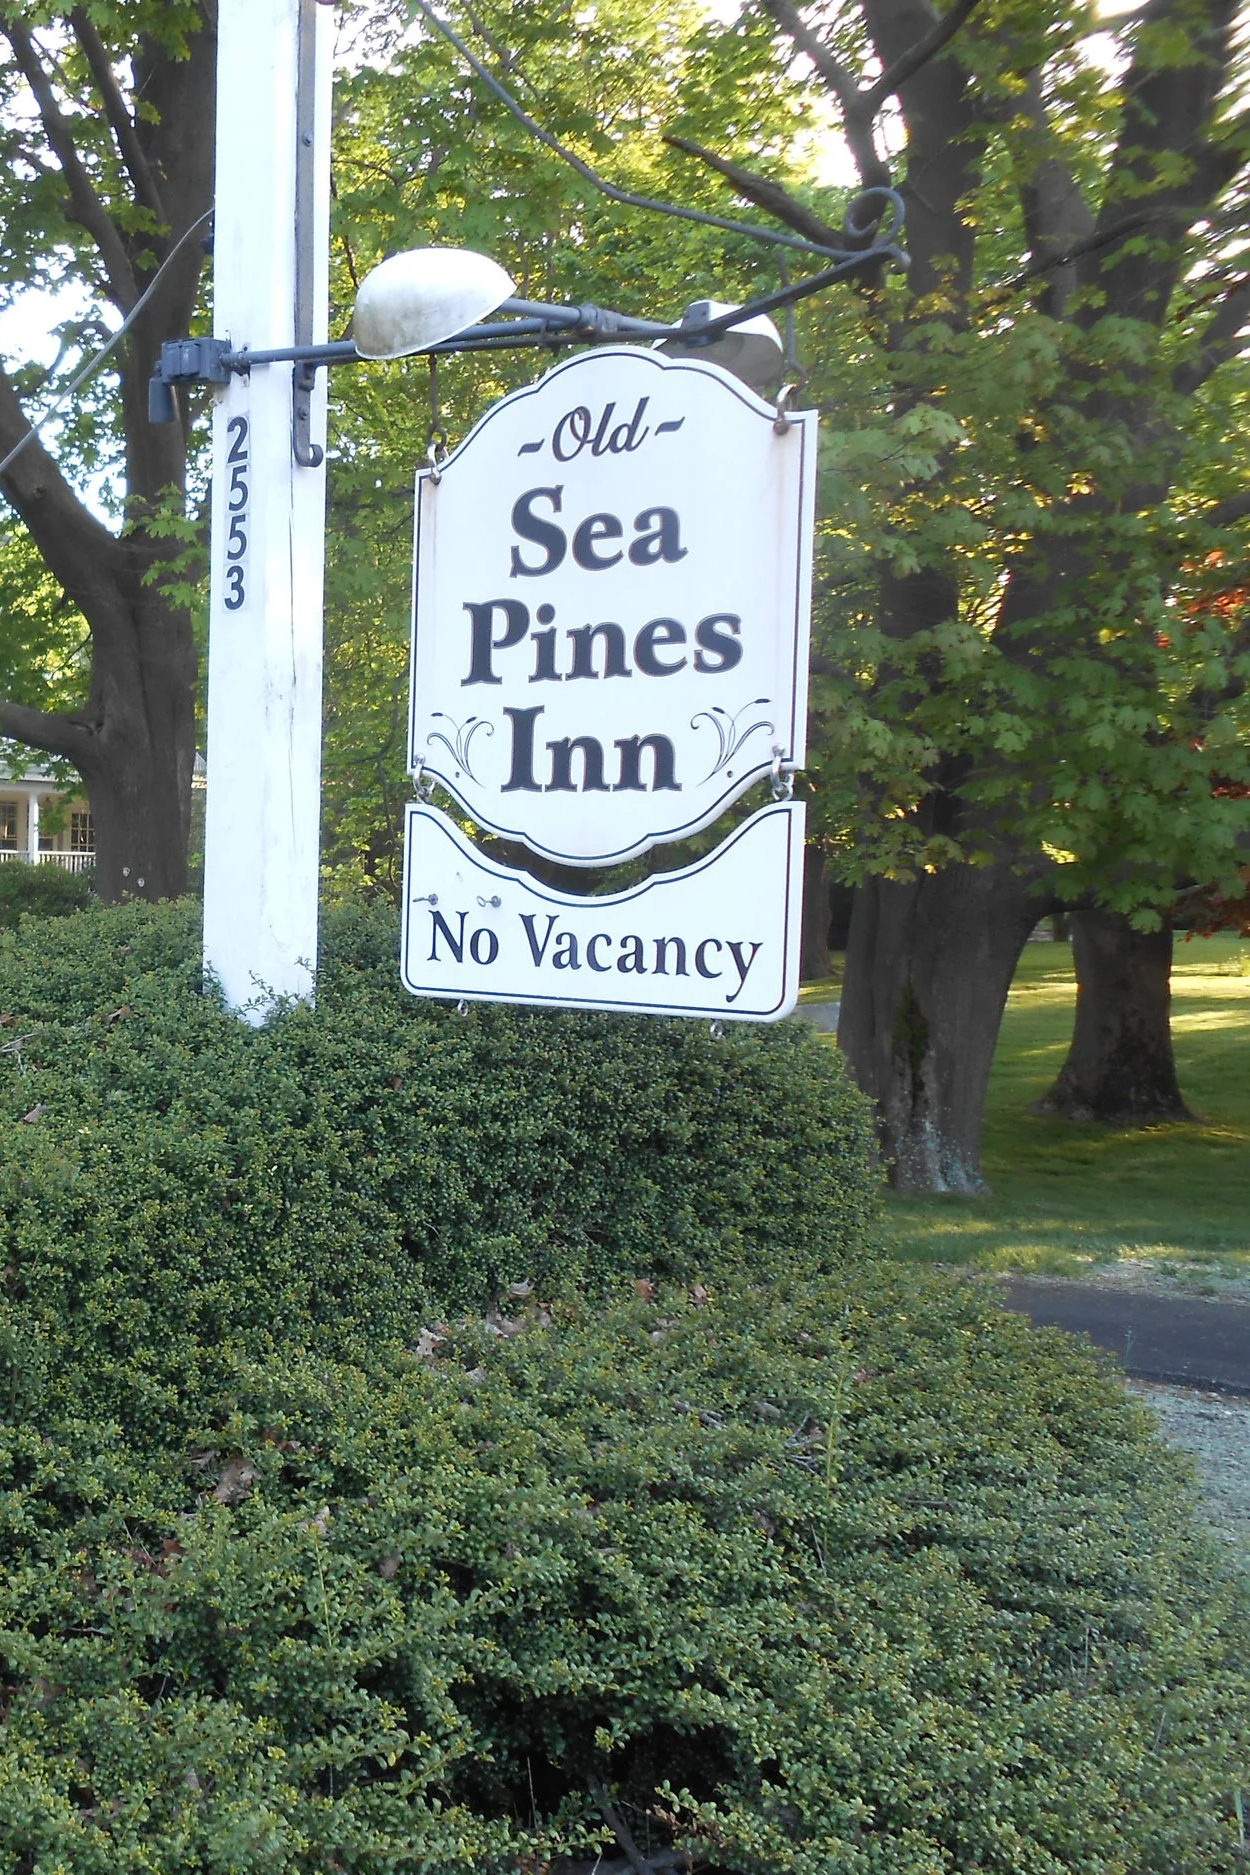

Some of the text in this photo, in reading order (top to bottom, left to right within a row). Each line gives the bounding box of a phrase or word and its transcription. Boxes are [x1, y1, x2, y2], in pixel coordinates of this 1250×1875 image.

[224, 416, 249, 611] 2553
[509, 484, 689, 579] Sea
[460, 598, 744, 687] Pines
[500, 705, 683, 793] Inn
[426, 909, 764, 1003] No Vacancy
